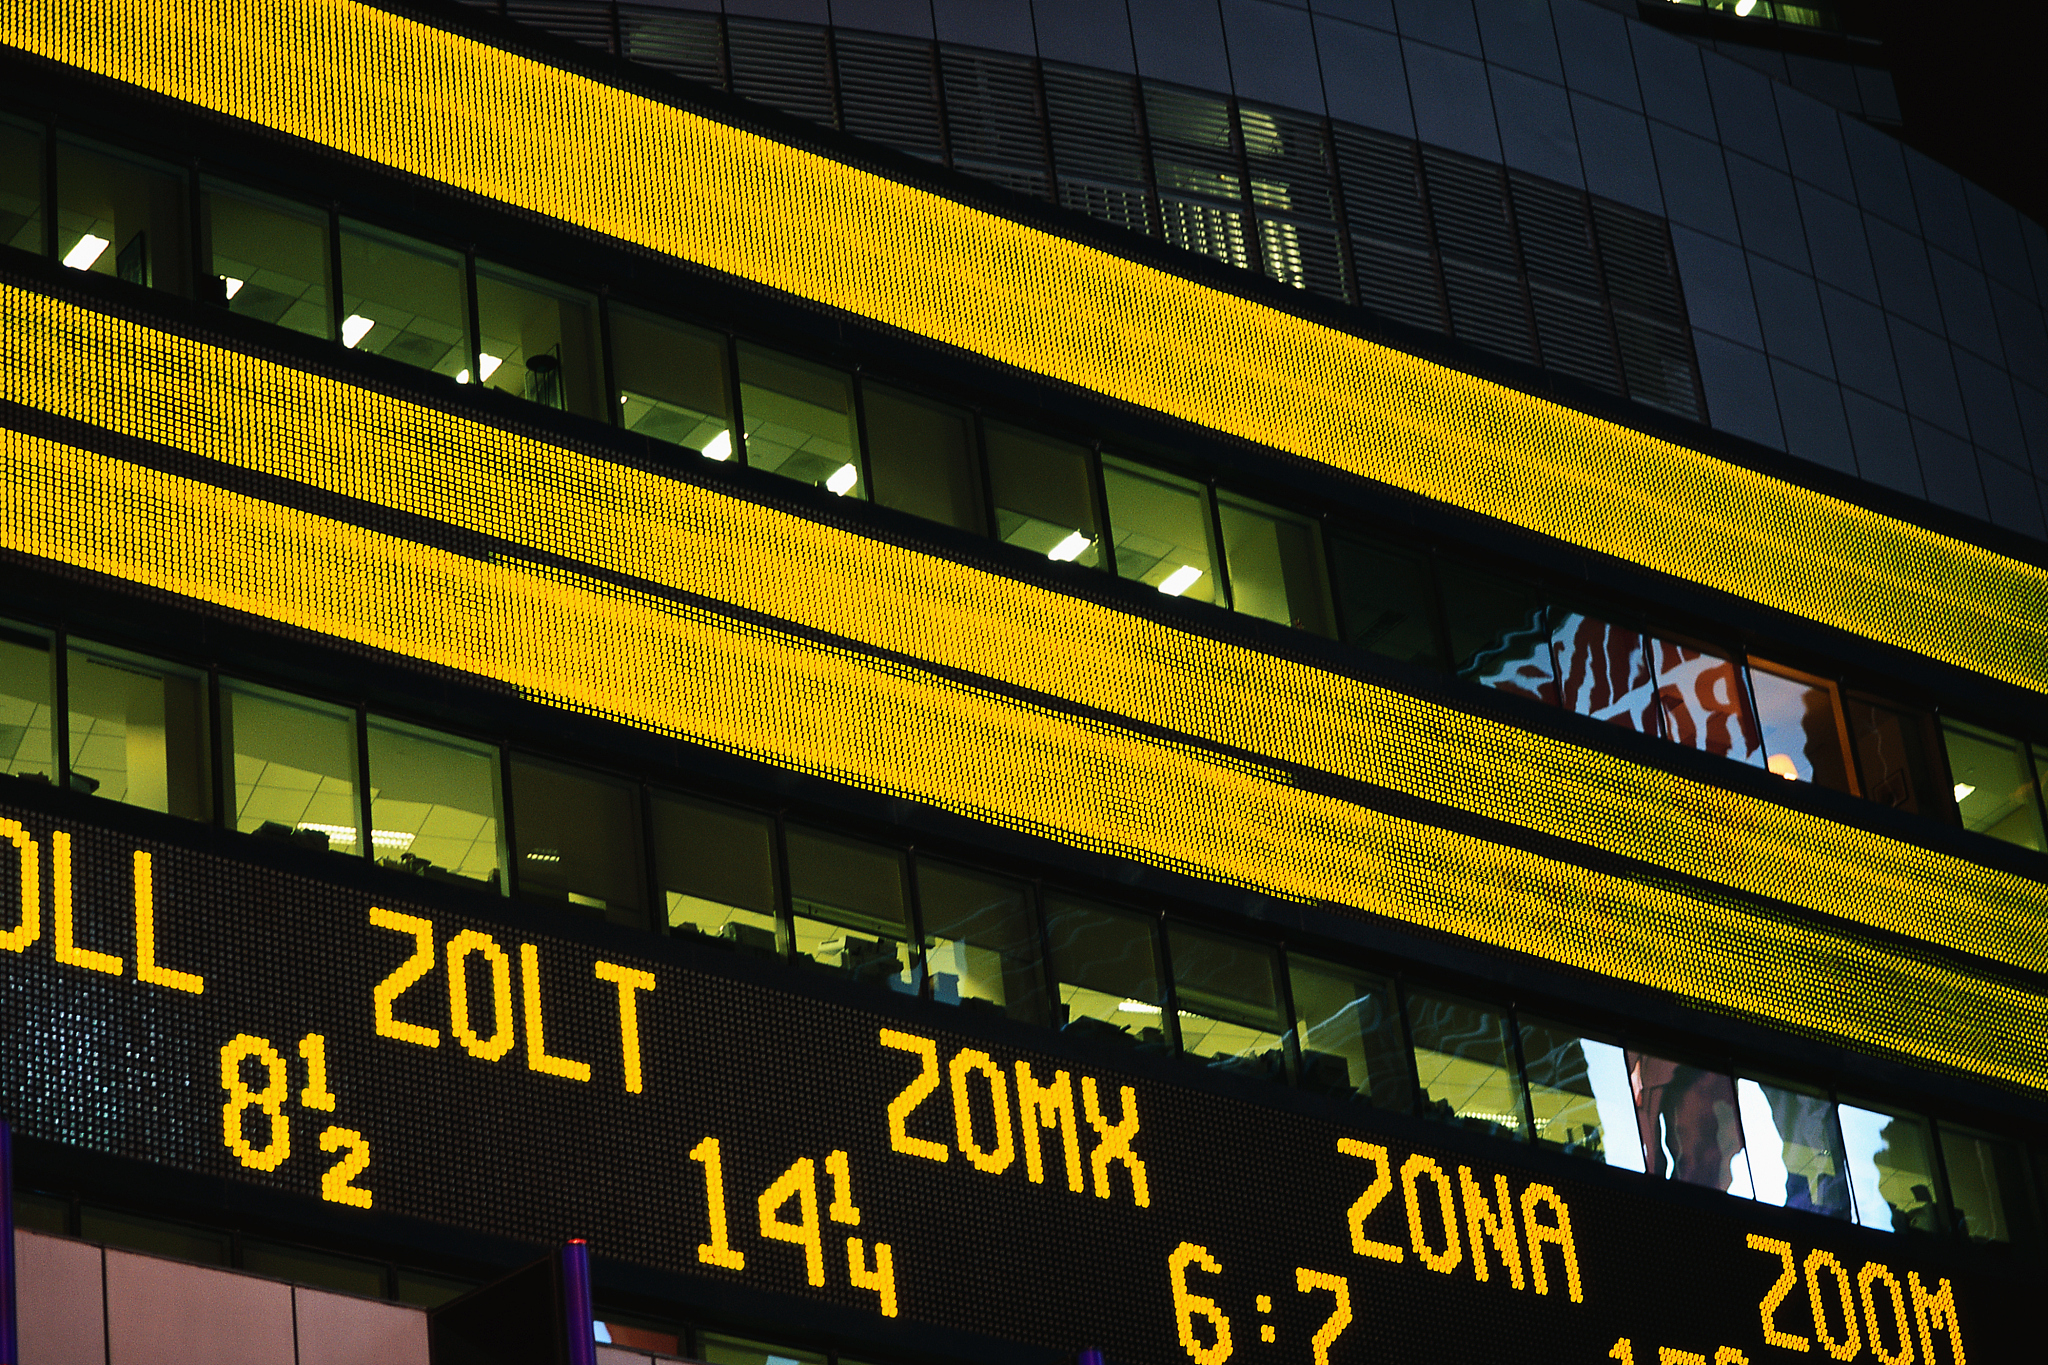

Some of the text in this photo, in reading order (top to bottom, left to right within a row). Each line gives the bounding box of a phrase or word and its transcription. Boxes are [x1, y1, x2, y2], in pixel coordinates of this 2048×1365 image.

[368, 905, 656, 1095] ZOLT
[878, 1026, 1151, 1209] ZOMX
[1335, 1136, 1584, 1304] ZONA
[1745, 1232, 1967, 1365] ZOOM
